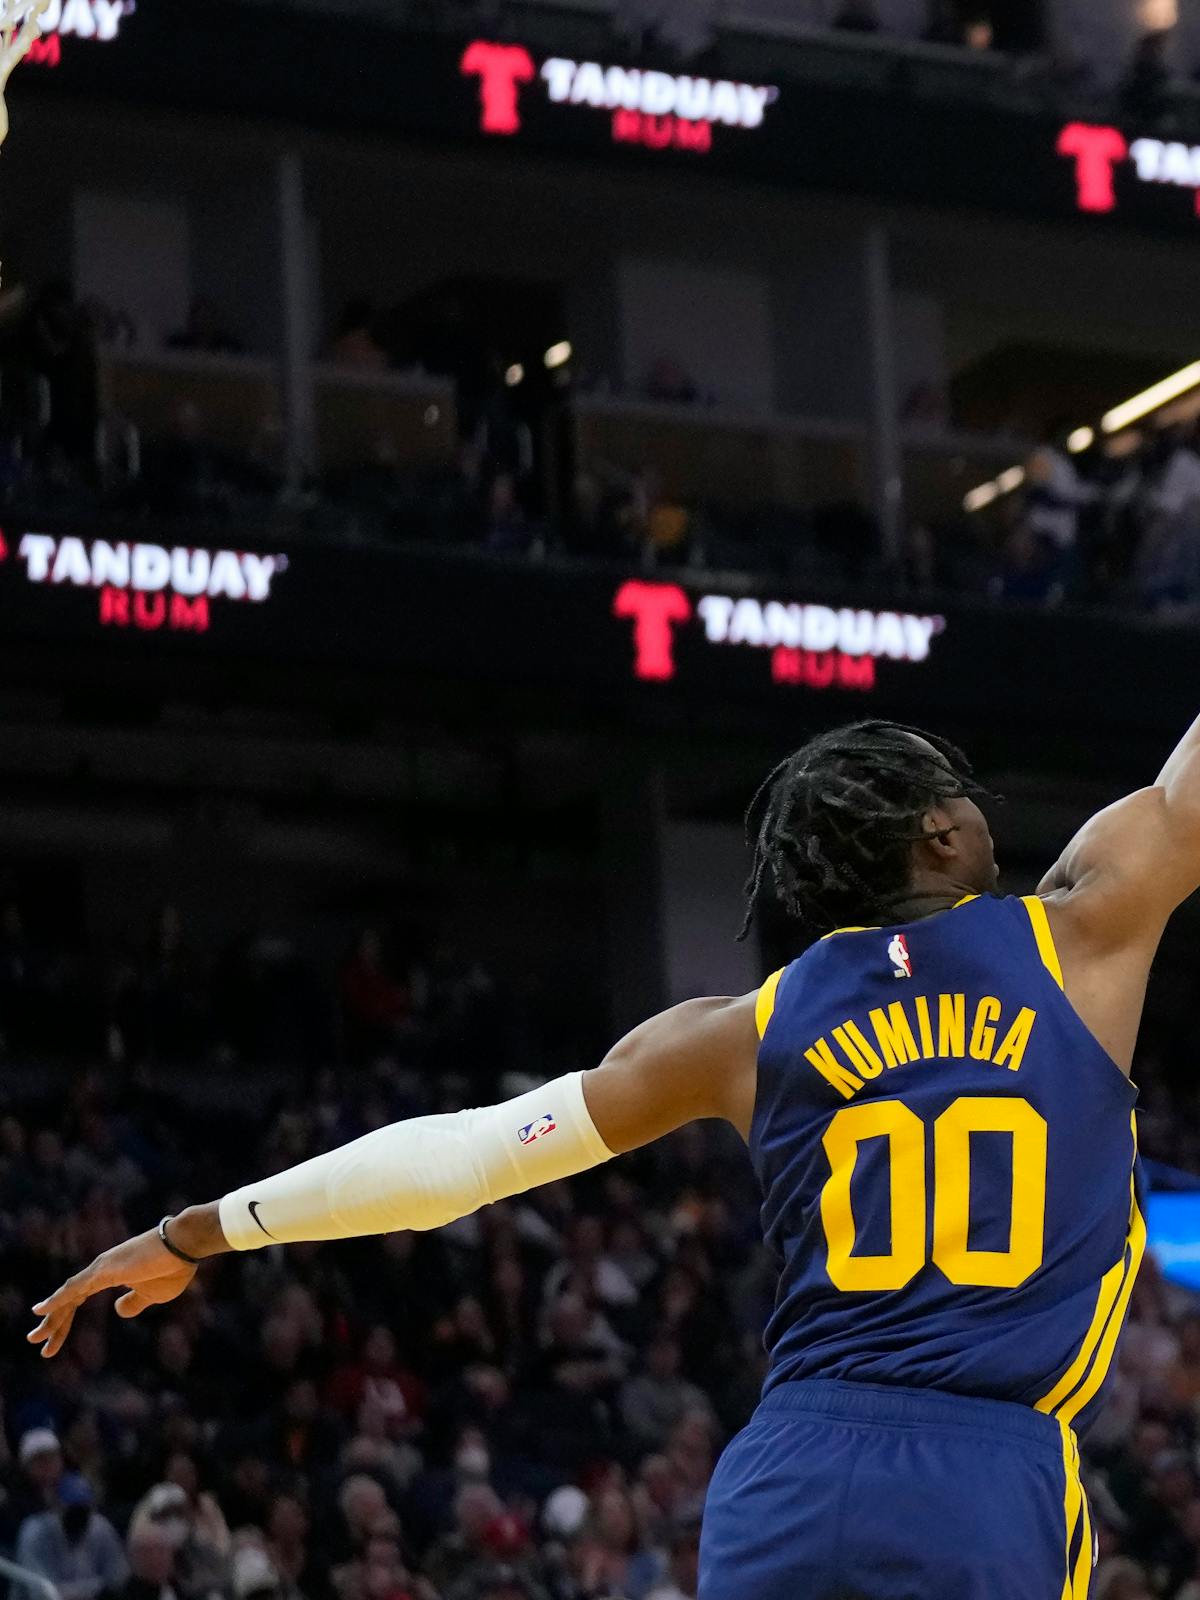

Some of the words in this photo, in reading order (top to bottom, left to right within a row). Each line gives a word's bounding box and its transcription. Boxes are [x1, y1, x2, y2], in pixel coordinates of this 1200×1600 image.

[540, 57, 768, 129] TANDUAY
[612, 107, 712, 153] RUM
[18, 533, 276, 602] TANDUAY
[100, 586, 209, 632] RUM
[698, 595, 934, 662] TANDUAY
[771, 646, 875, 690] RUM
[803, 993, 1037, 1100] KUMINGA
[820, 1096, 1048, 1292] 00
